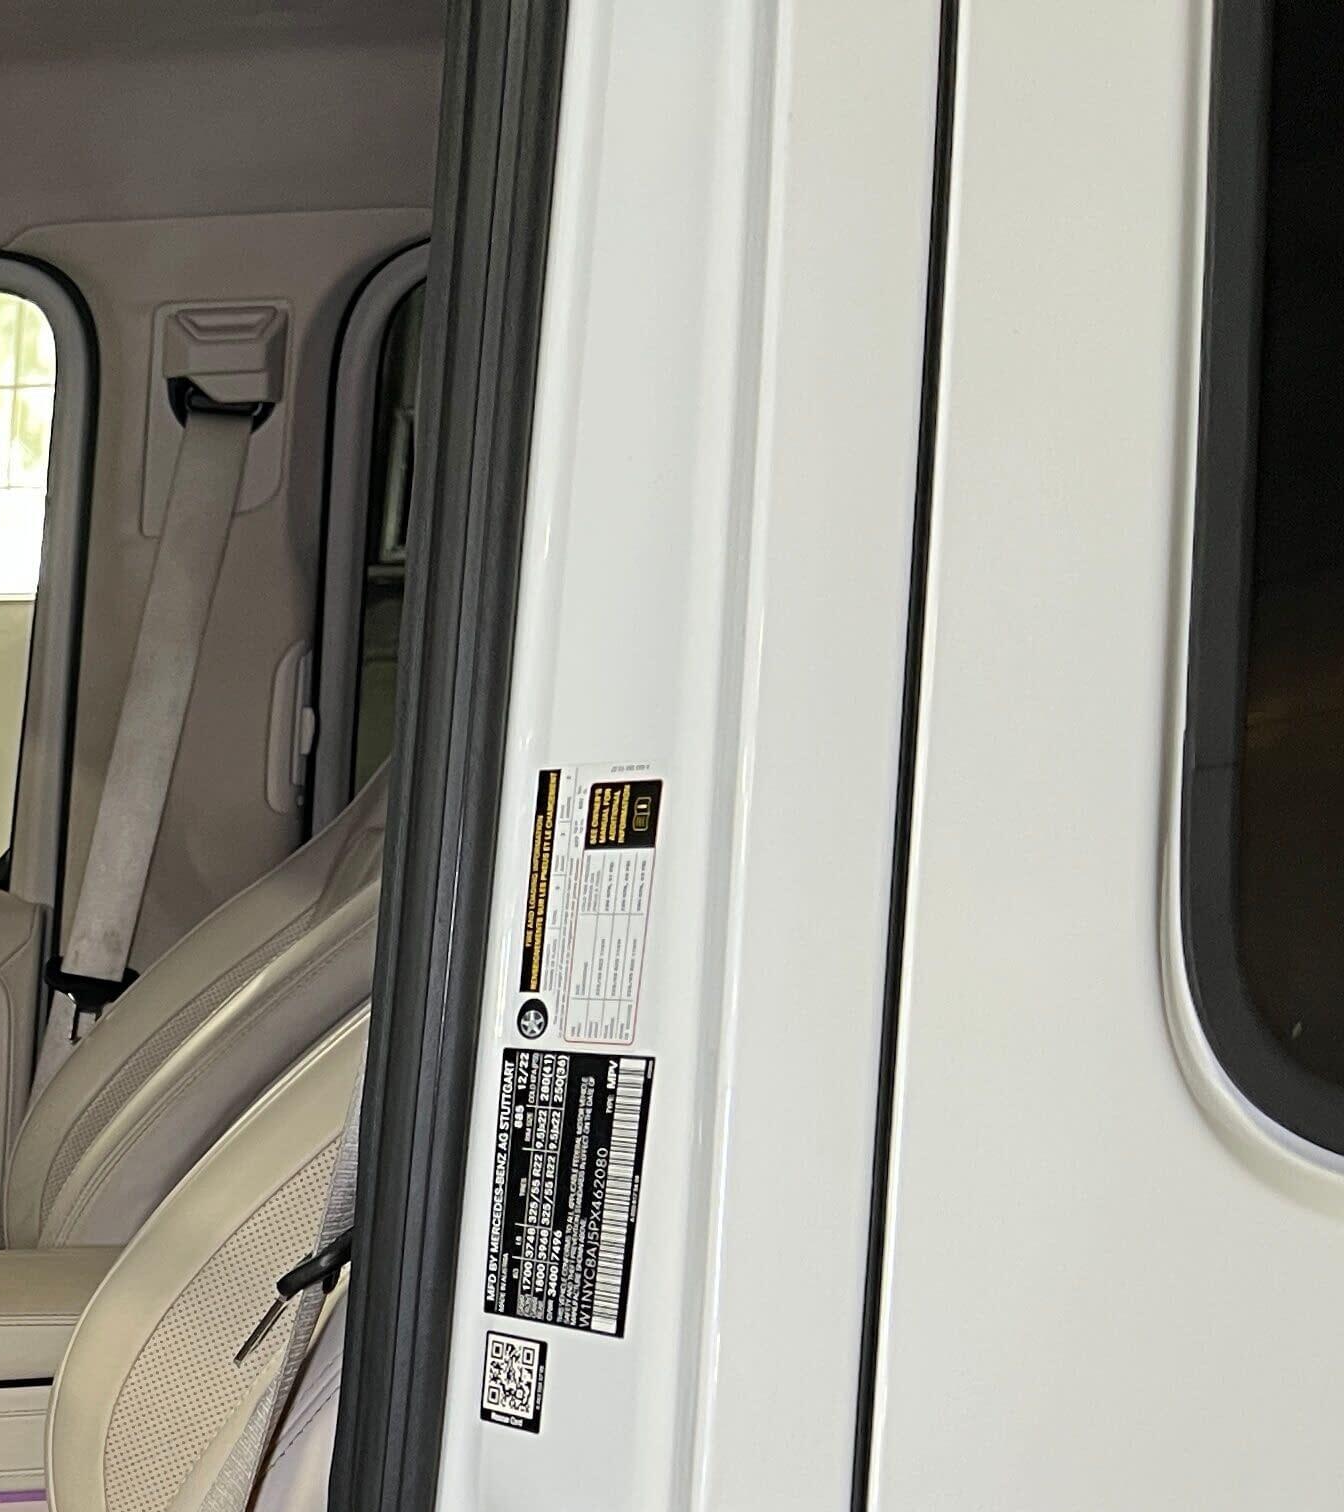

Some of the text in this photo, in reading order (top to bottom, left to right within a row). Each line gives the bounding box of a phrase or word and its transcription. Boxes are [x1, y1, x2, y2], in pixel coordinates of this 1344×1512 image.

[599, 787, 611, 842] MANUAL FOR
[517, 1052, 529, 1090] 12/22
[606, 1059, 618, 1088] MPV
[486, 1060, 514, 1301] MFD BY MERCEDES-BENZ AG STUTTGART
[522, 1261, 532, 1290] 1700
[532, 1153, 542, 1176] R22
[535, 1263, 545, 1292] 1800
[545, 1155, 556, 1178] R22
[551, 1229, 562, 1260] 7496
[578, 1146, 608, 1328] W1NYC8AJ5PX462080
[547, 1265, 558, 1297] 3400
